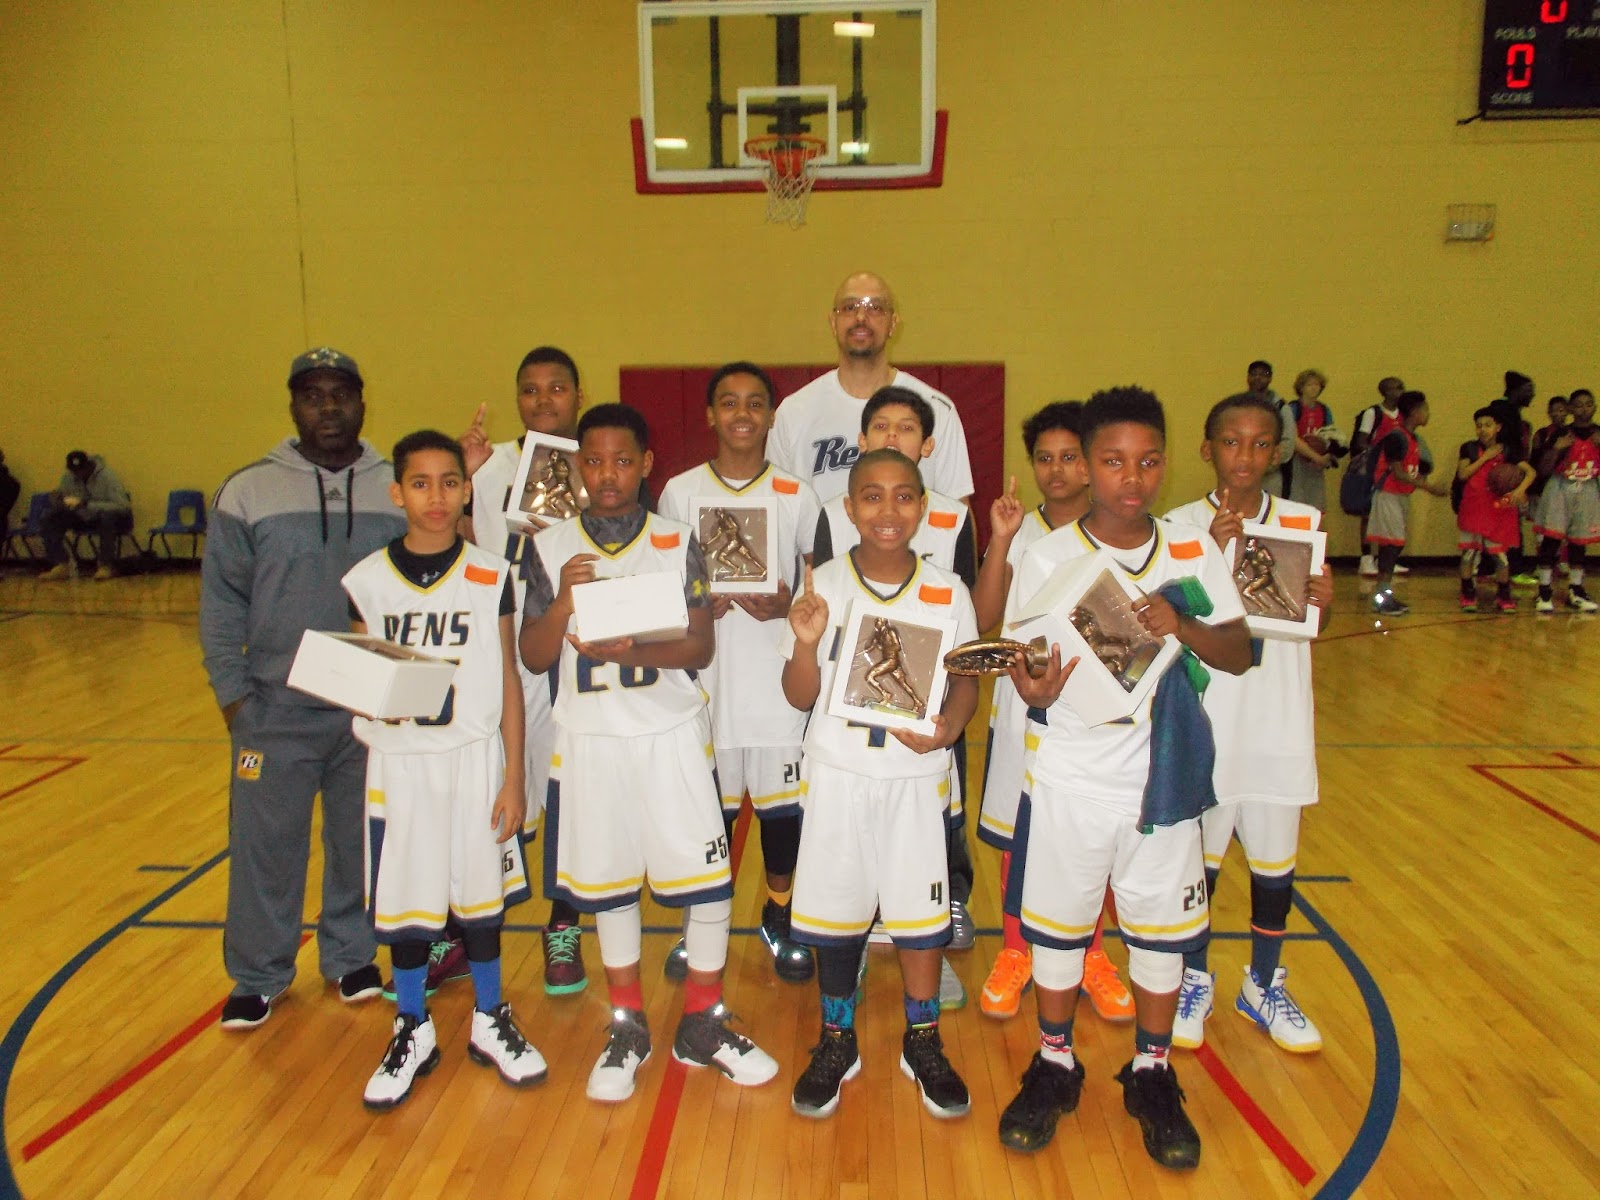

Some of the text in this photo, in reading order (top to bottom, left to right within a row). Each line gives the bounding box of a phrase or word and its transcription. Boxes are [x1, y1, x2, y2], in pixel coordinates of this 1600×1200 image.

[1506, 43, 1534, 88] 0
[812, 435, 861, 476] Re
[383, 610, 471, 646] RENS
[783, 761, 801, 783] 21
[705, 834, 727, 864] 25
[930, 881, 943, 905] 4
[1183, 879, 1205, 911] 23
